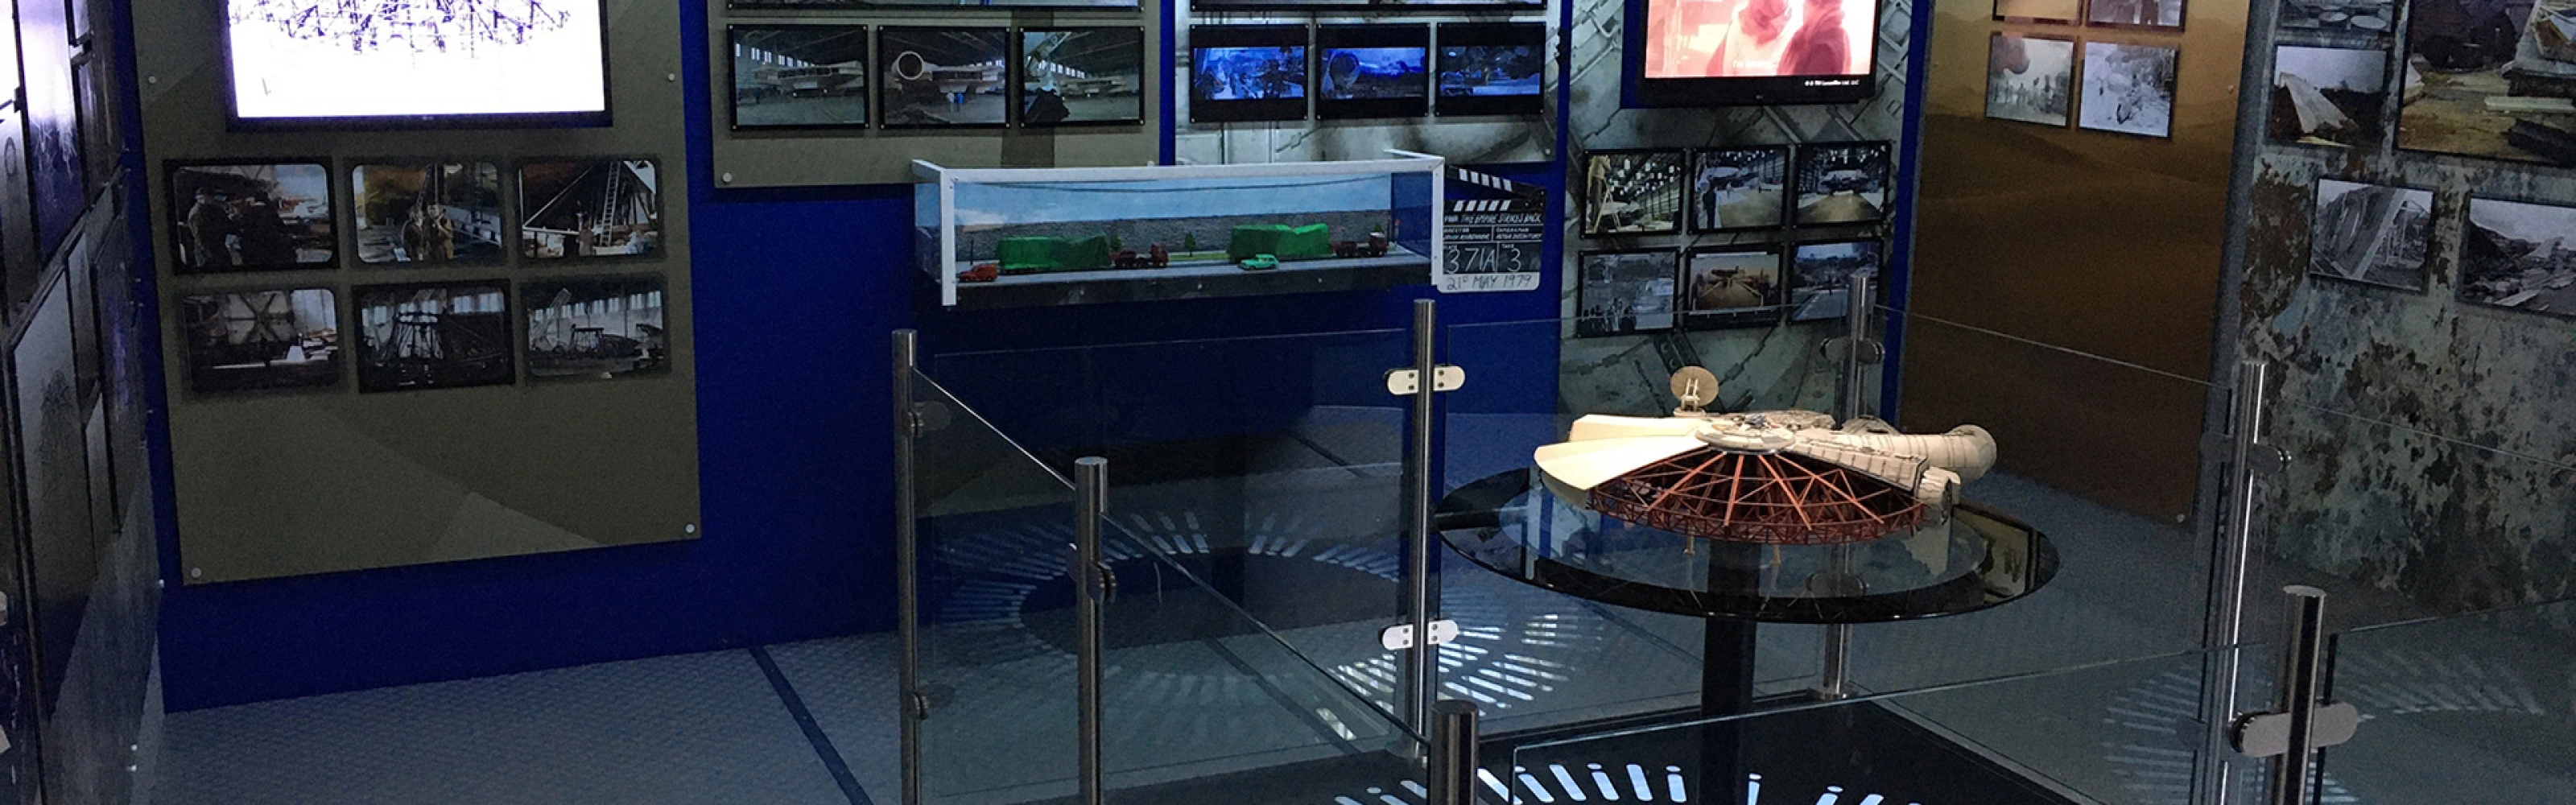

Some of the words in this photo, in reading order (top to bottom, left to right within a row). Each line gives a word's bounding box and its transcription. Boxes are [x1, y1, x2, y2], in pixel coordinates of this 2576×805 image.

[1507, 248, 1522, 272] 3
[1472, 275, 1498, 289] MAY
[1503, 275, 1532, 288] 1979
